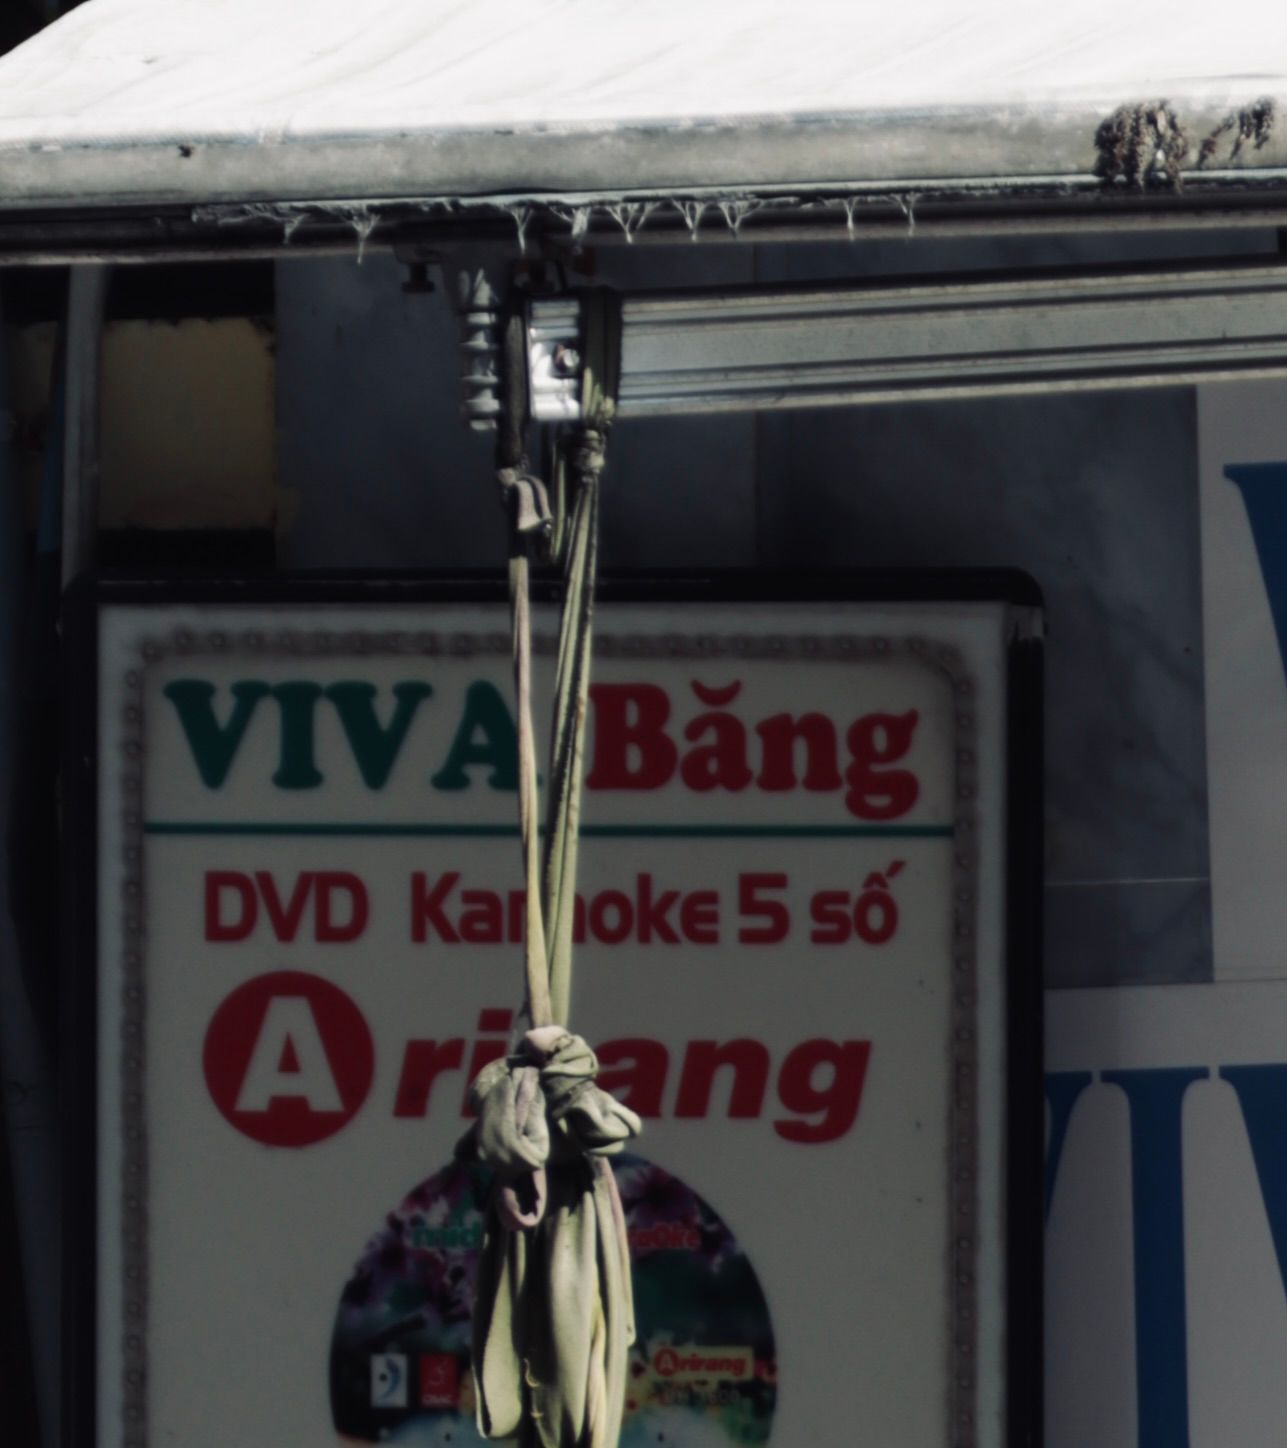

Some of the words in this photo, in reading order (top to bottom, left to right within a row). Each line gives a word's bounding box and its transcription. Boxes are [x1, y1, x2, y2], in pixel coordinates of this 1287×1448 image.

[166, 681, 540, 790] VIVA
[585, 680, 920, 820] Băng
[205, 871, 369, 944] DVD
[737, 872, 790, 944] 5
[809, 860, 906, 944] số
